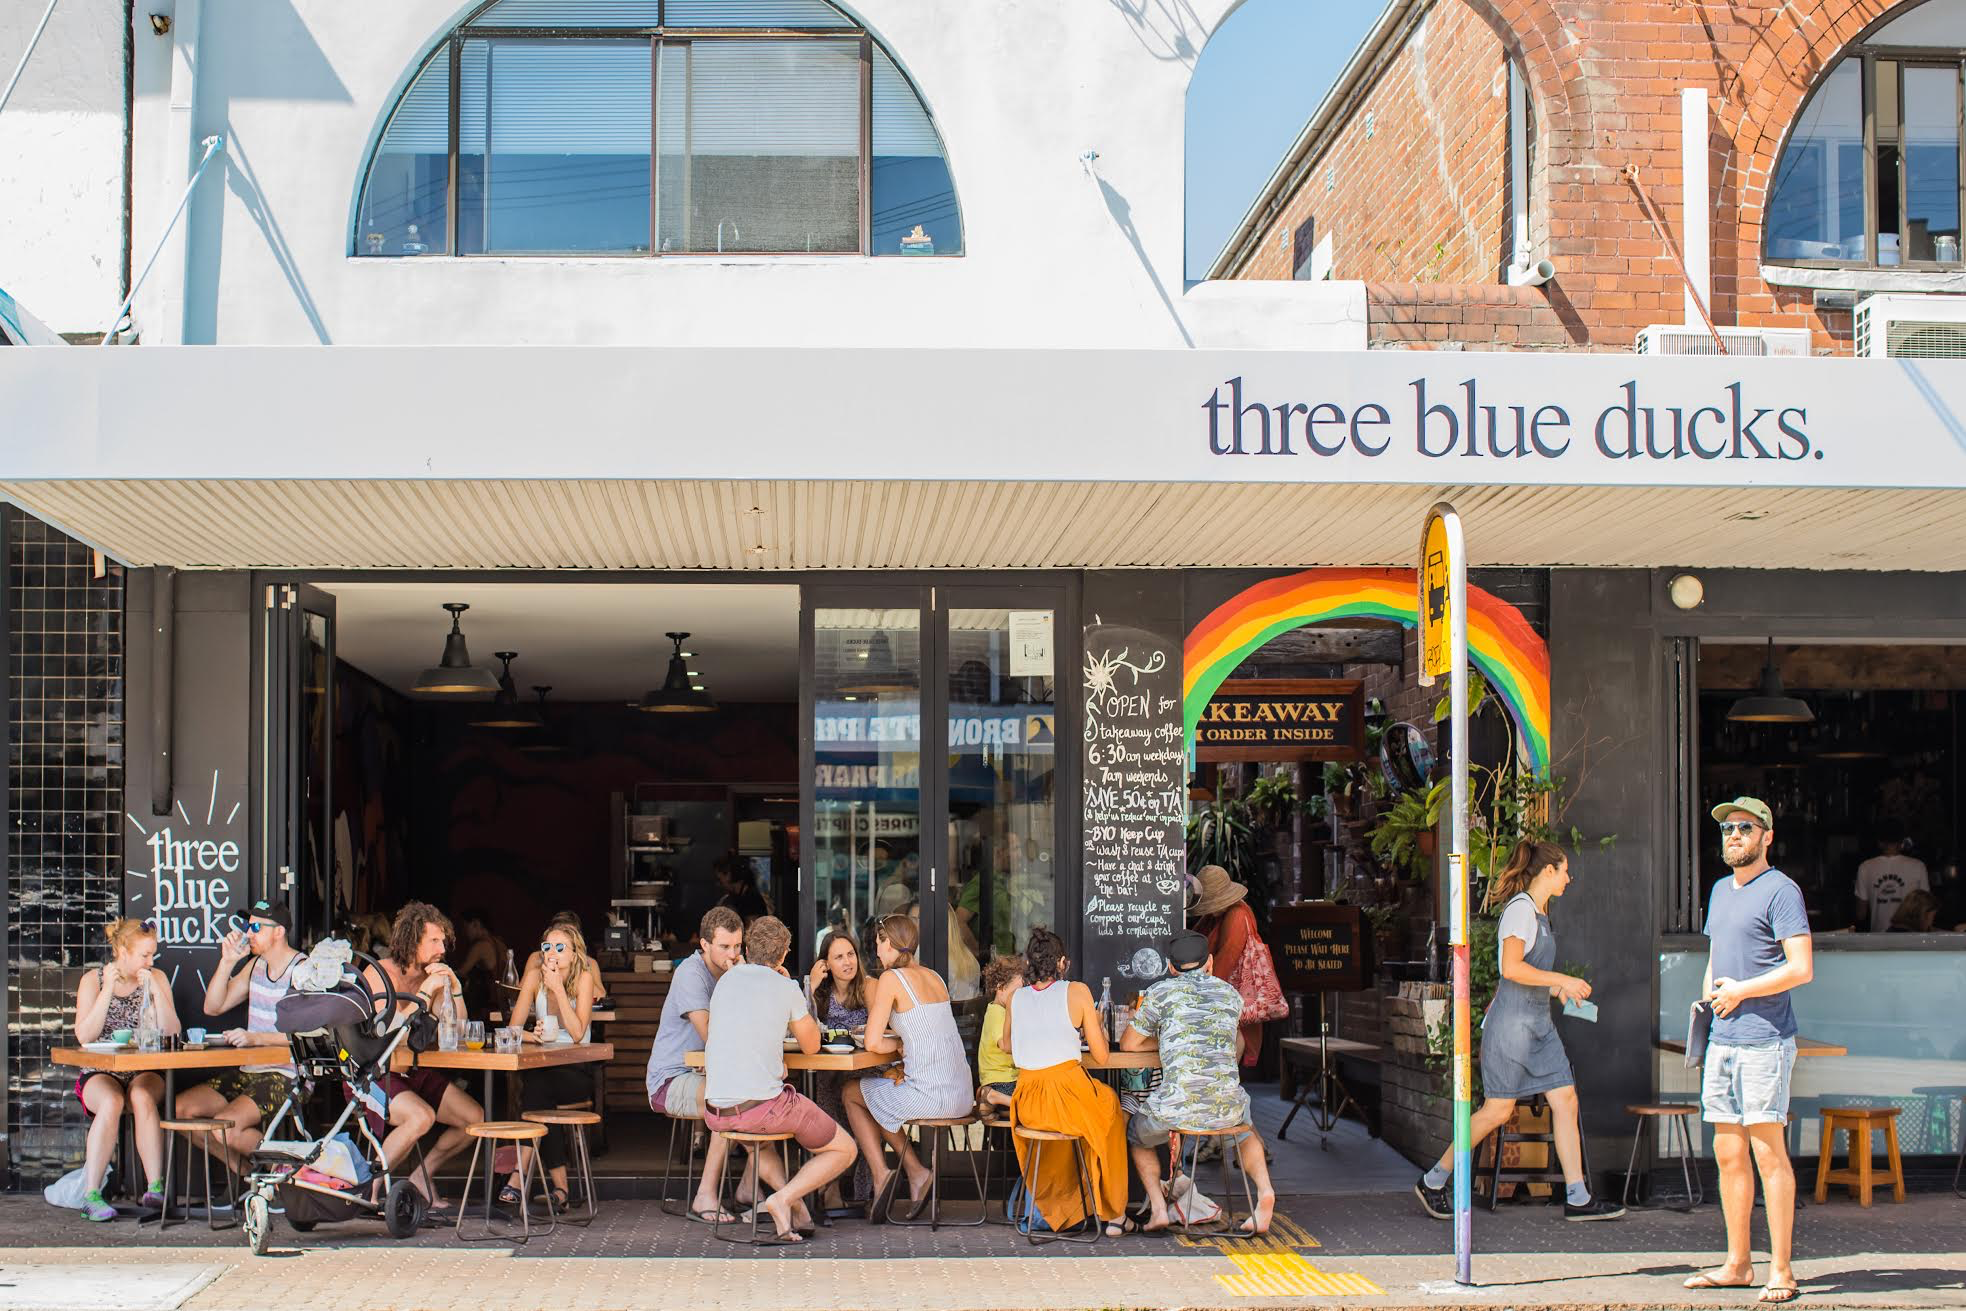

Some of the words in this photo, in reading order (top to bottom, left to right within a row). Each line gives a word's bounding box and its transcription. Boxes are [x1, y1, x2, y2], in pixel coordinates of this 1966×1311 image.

[1201, 376, 1391, 457] three
[1408, 378, 1571, 459] blue
[1594, 380, 1825, 461] ducks.
[1107, 689, 1150, 719] OPEN
[1158, 695, 1176, 714] for
[1200, 702, 1344, 721] KEAWAY
[1100, 723, 1152, 746] takeaway
[1154, 723, 1184, 743] coffee
[1206, 729, 1267, 740] ORDER
[1273, 728, 1334, 740] INSIDE
[1143, 747, 1184, 766] weekdays
[1099, 767, 1122, 788] 7am
[1126, 769, 1168, 787] weekends
[1086, 787, 1119, 811] SAVE
[1120, 812, 1142, 822] reduce
[1093, 826, 1116, 841] BYO
[1120, 827, 1144, 844] Keep
[1145, 826, 1165, 843] Cup
[146, 827, 240, 872] three
[1131, 846, 1154, 857] reuse
[1098, 859, 1116, 871] Have
[1128, 861, 1144, 873] chat
[1155, 860, 1176, 875] drink
[151, 863, 230, 911] blue
[1094, 873, 1110, 886] your
[1112, 870, 1138, 886] coffee
[1142, 873, 1152, 883] at
[1099, 883, 1113, 898] the
[1116, 884, 1138, 896] bar!
[1098, 899, 1125, 912] Please
[1128, 900, 1157, 919] recycle
[1162, 904, 1171, 914] or
[1090, 913, 1123, 926] compost
[1128, 914, 1140, 923] our
